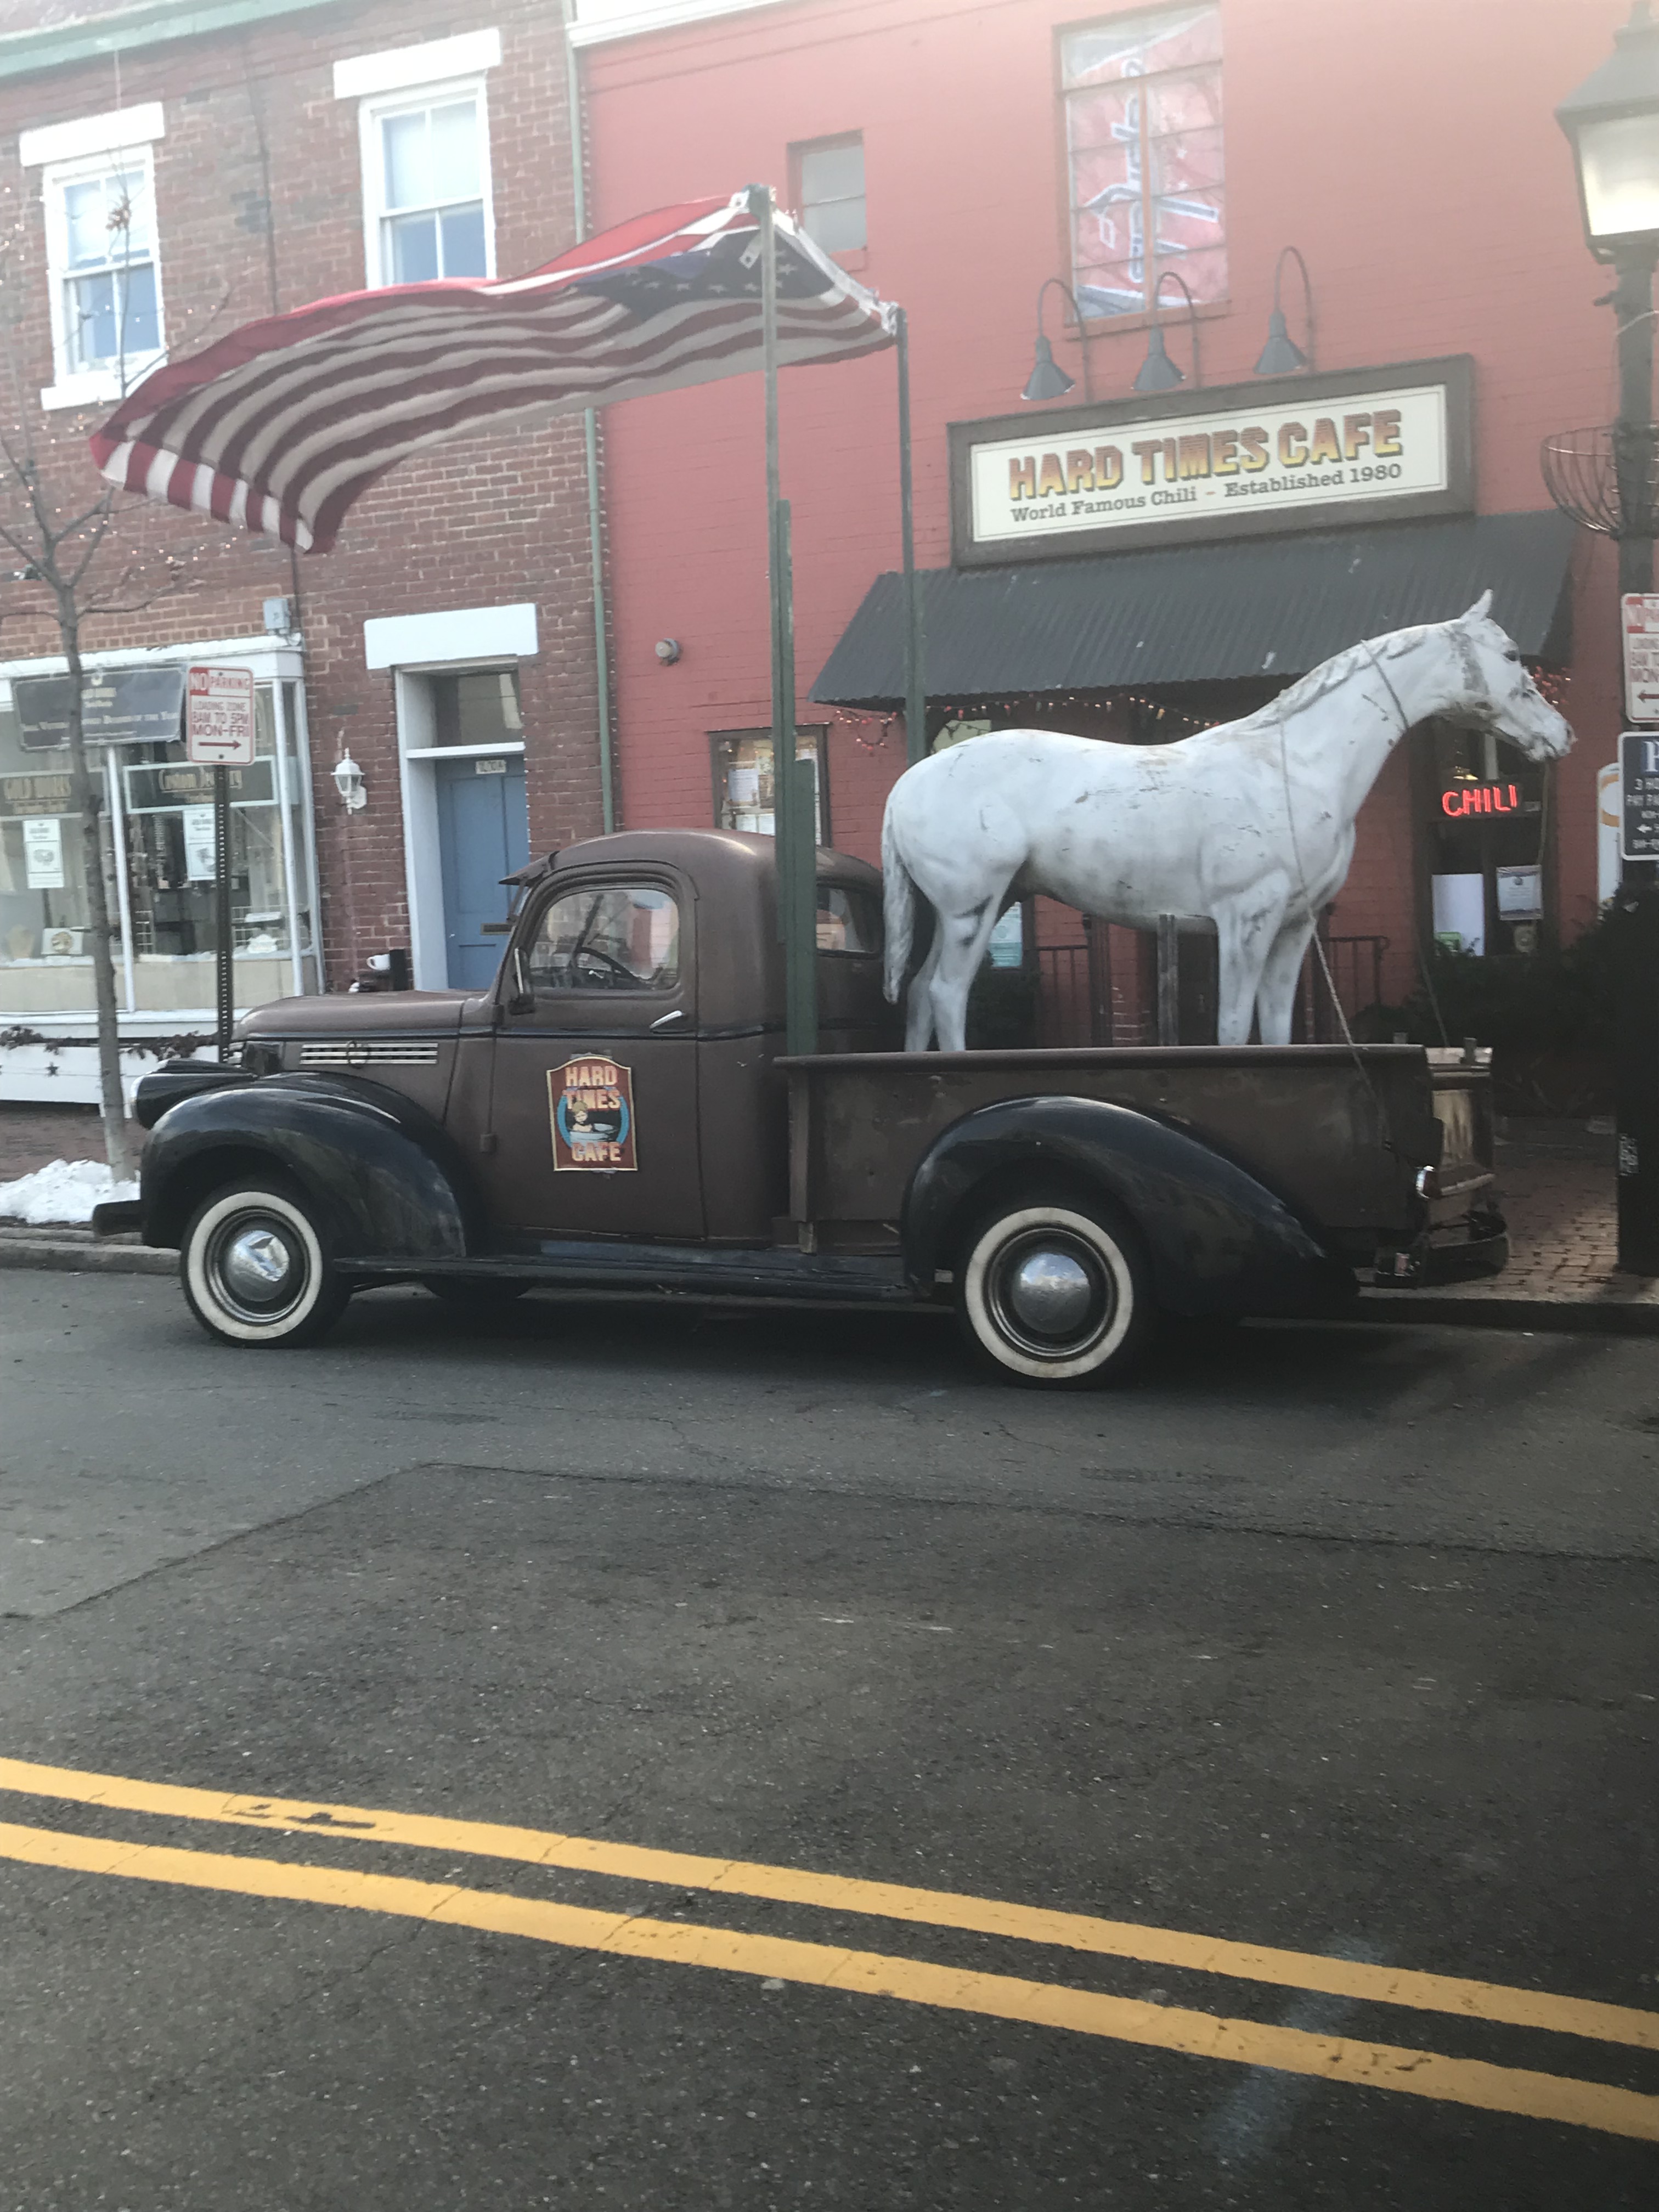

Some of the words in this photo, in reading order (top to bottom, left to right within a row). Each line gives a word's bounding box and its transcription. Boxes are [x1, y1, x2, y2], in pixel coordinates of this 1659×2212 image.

[1008, 445, 1124, 501] HARD
[1131, 426, 1270, 486] TIMES
[1278, 409, 1403, 469] CAFE
[1010, 503, 1066, 522] World
[1071, 496, 1146, 515] Famous
[1151, 487, 1197, 506] Chili
[1224, 470, 1345, 497] Established
[1350, 463, 1402, 483] 1980
[191, 673, 207, 691] NO
[211, 676, 251, 690] PARKING
[215, 712, 227, 724] TO
[1442, 784, 1517, 816] CHILI
[565, 1065, 618, 1087] HARD
[571, 1141, 622, 1162] CAFE
